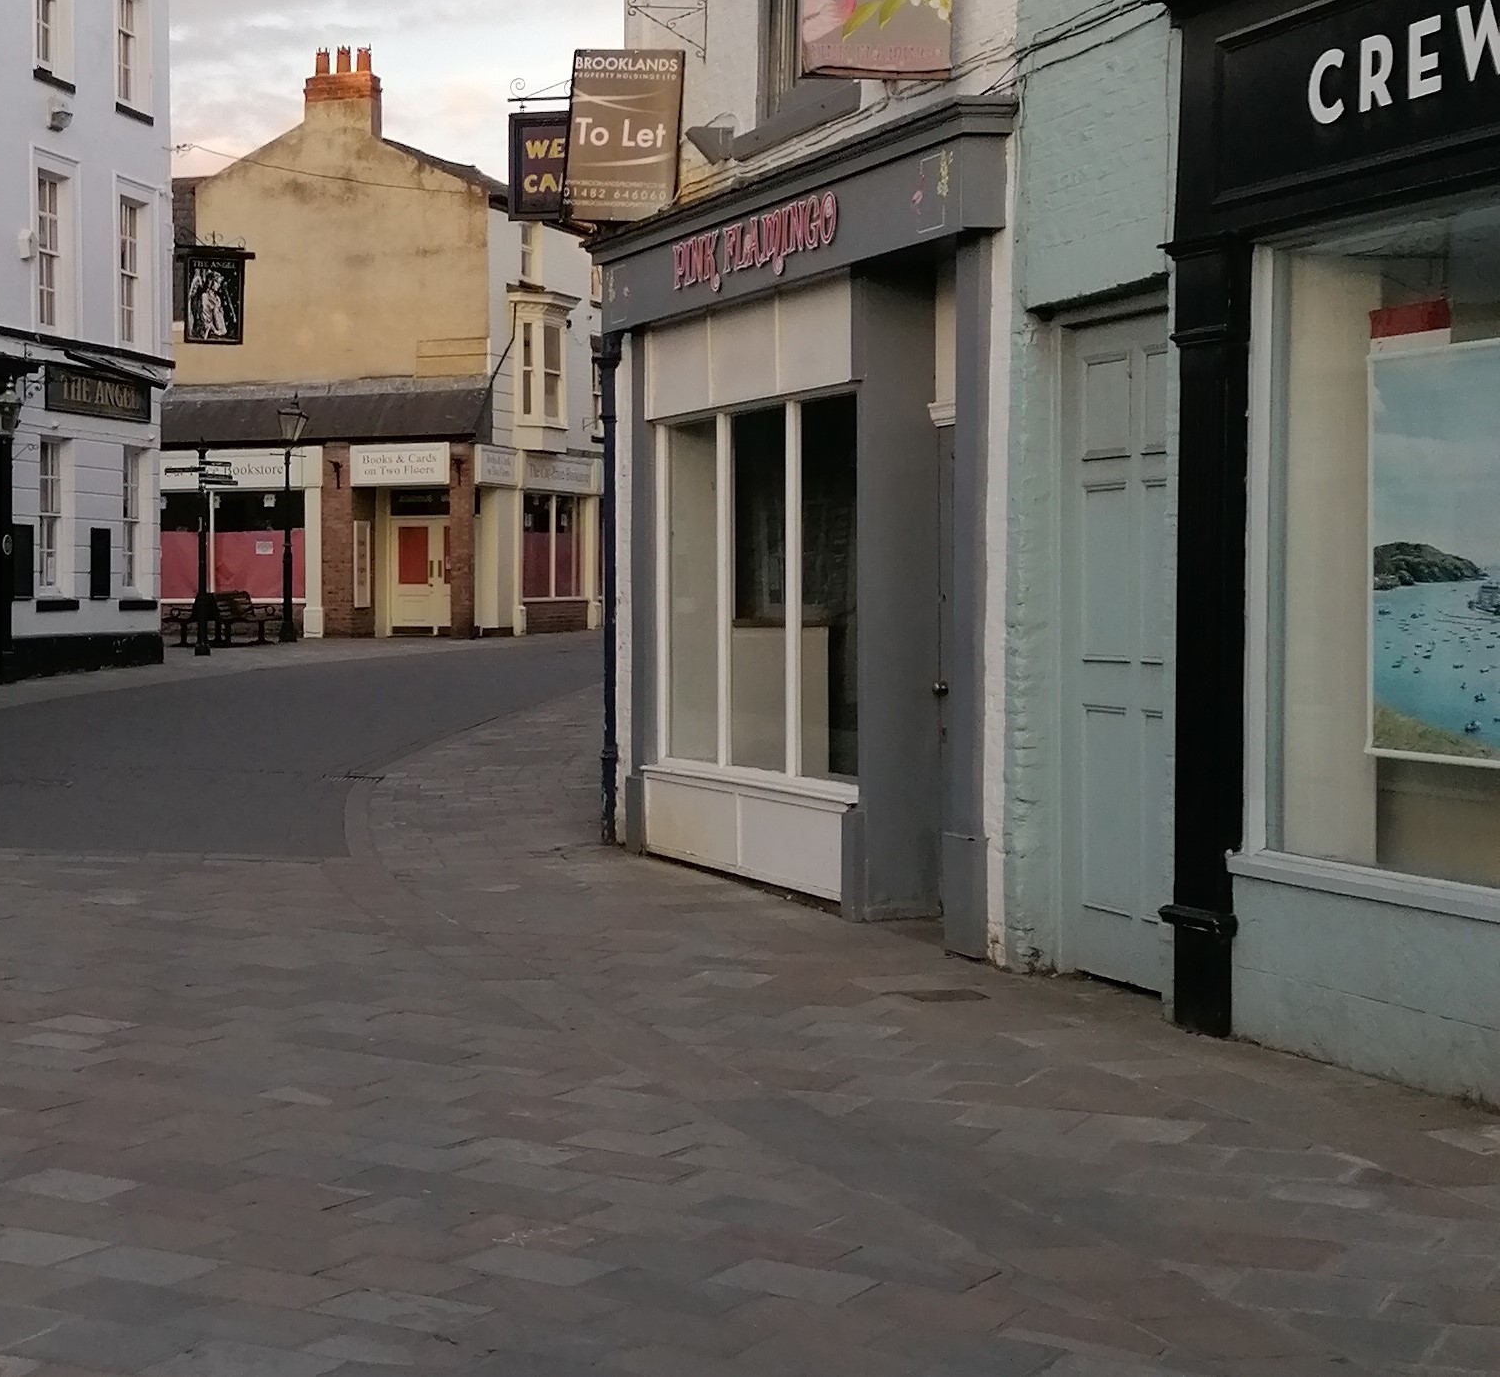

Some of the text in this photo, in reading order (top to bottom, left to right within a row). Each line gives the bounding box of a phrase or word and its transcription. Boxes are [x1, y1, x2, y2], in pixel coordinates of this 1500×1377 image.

[575, 56, 679, 72] BROOKLANDS
[574, 71, 616, 80] PROPERTY
[575, 116, 666, 148] To Let
[563, 186, 667, 201] 01482 646060
[672, 191, 838, 292] PINK FLAMINGO
[60, 374, 139, 410] THE ANGEL
[362, 452, 437, 465] Books & Cards
[224, 463, 284, 476] Bookstore
[364, 464, 435, 476] on Two Floors
